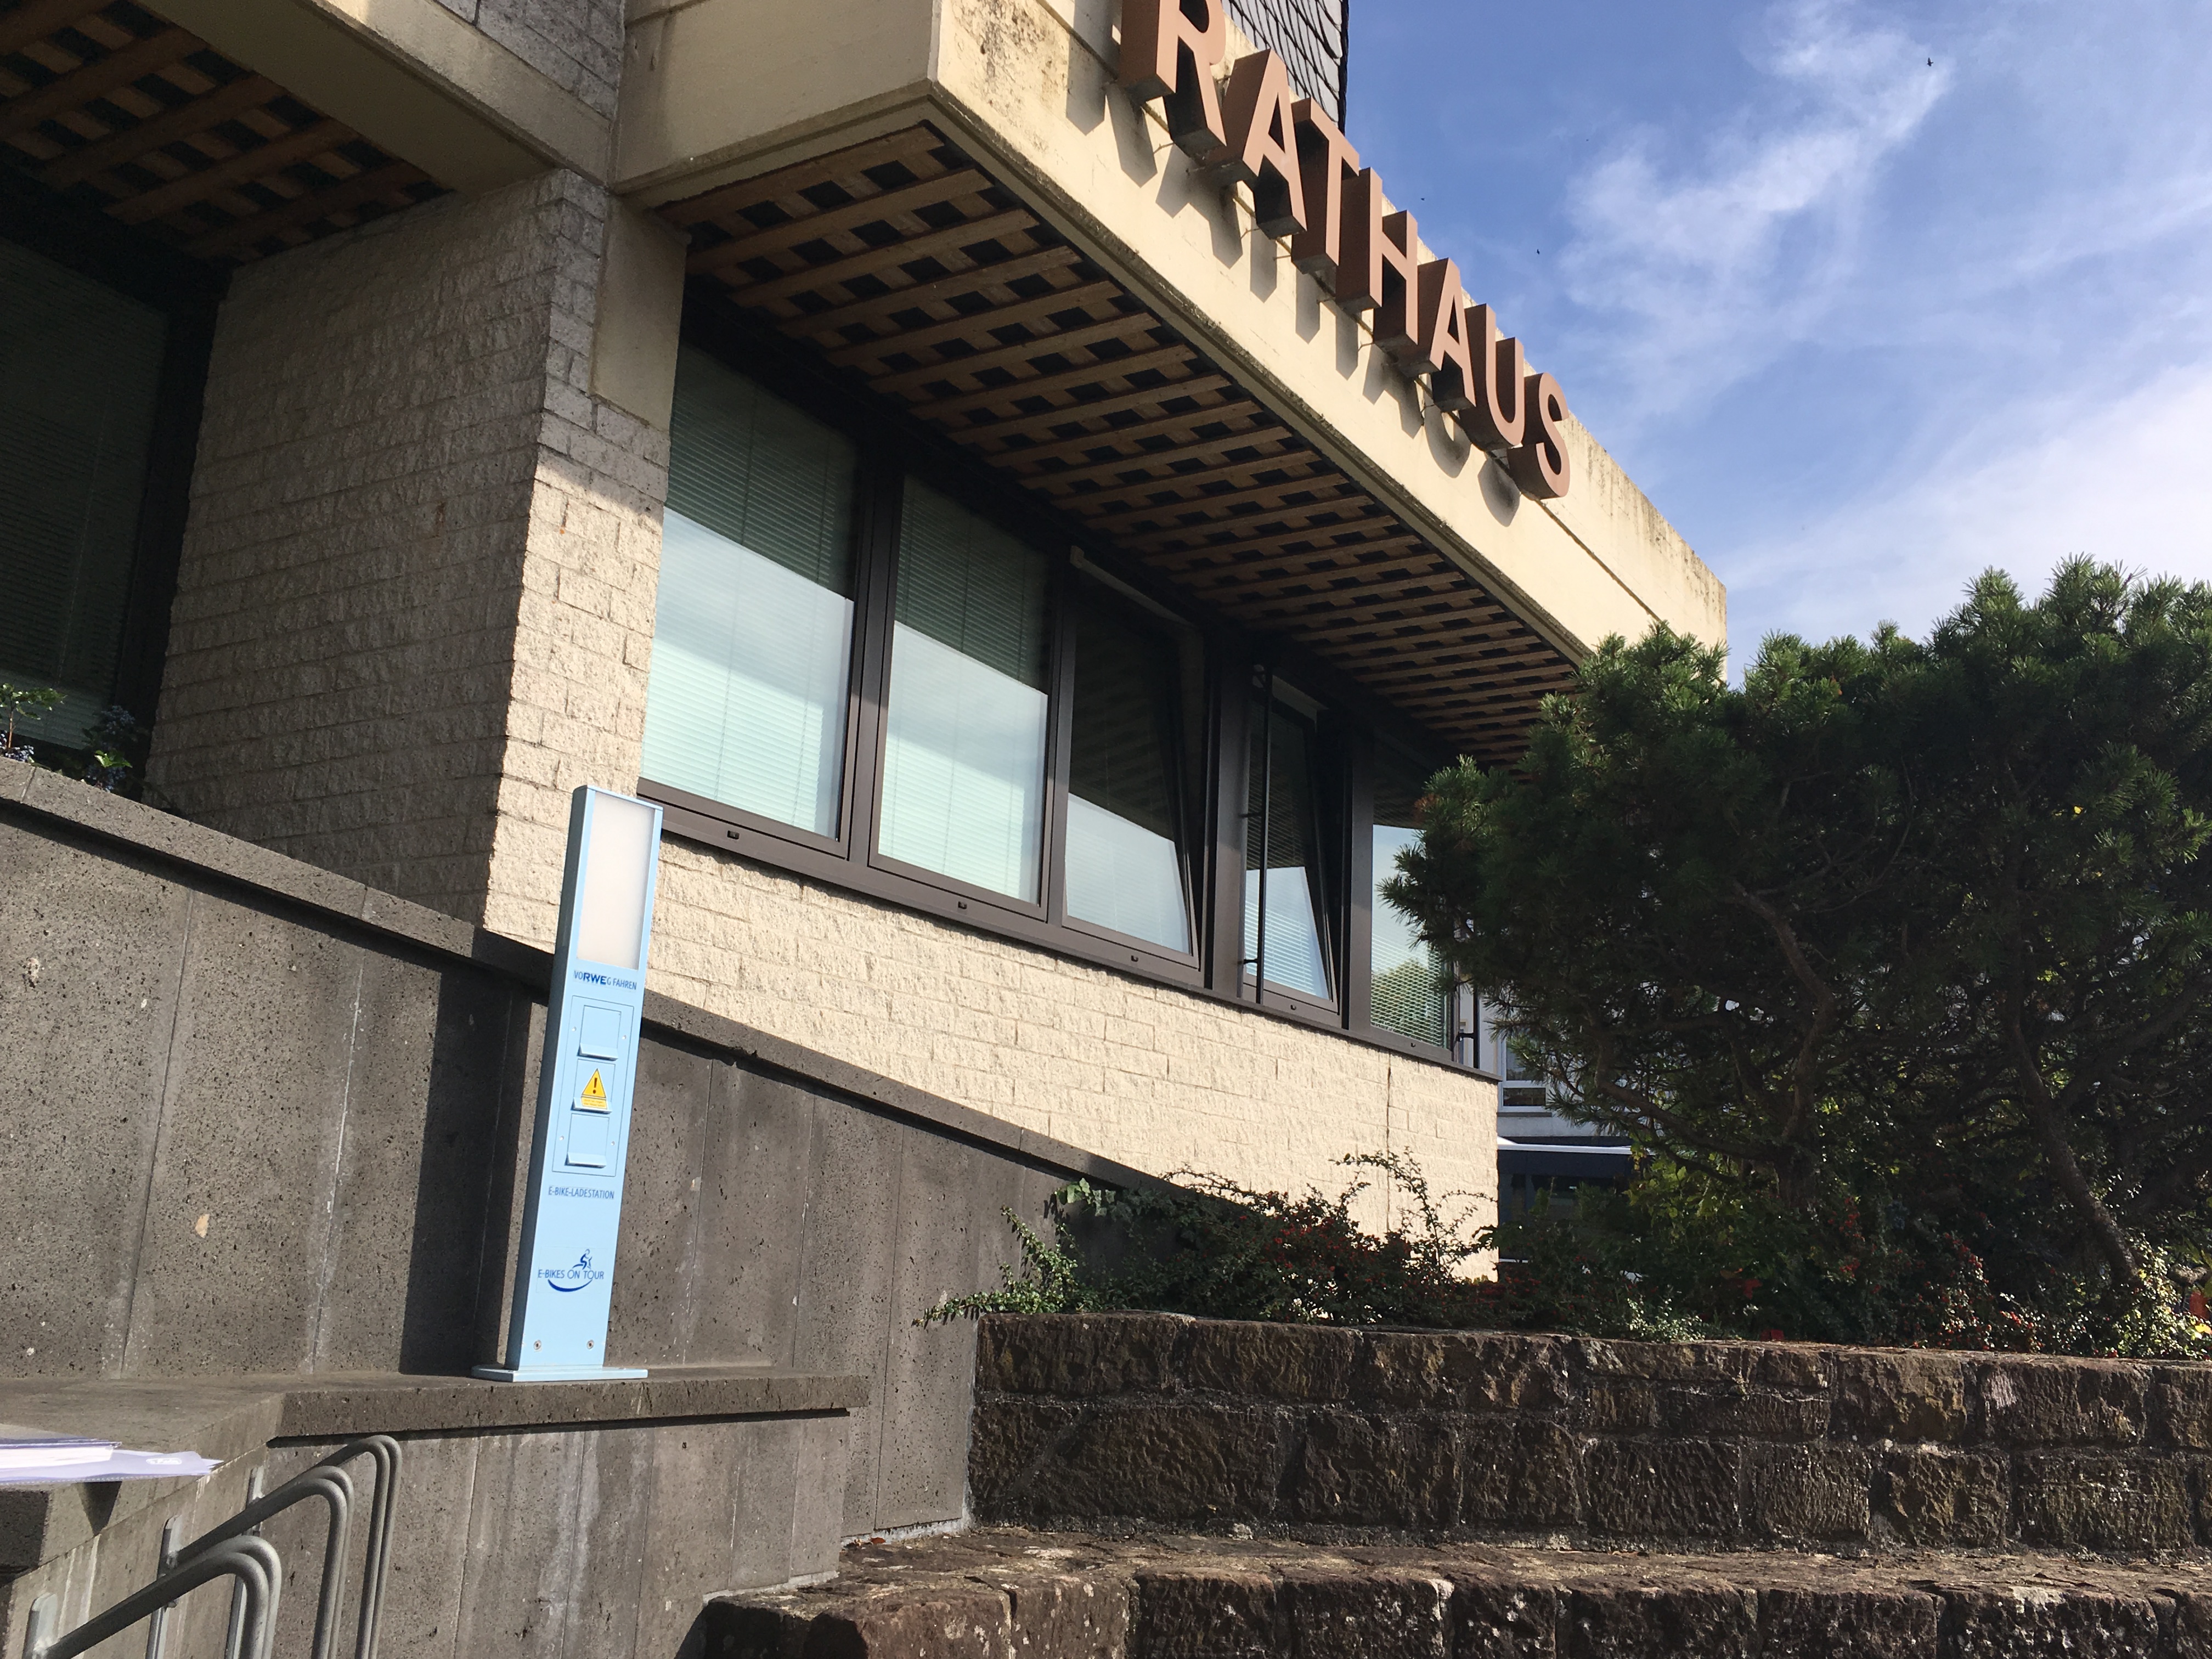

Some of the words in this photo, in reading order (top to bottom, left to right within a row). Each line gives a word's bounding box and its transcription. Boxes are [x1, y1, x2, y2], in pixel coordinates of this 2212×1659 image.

[1147, 0, 1571, 498] RATHAUS
[574, 970, 611, 985] VORWEG
[613, 978, 637, 990] FAHREN
[549, 1186, 614, 1199] E-BIKE-LADESTATION
[538, 1269, 565, 1278] E-BIKES
[567, 1269, 580, 1279] ON
[583, 1270, 604, 1279] TOUR
